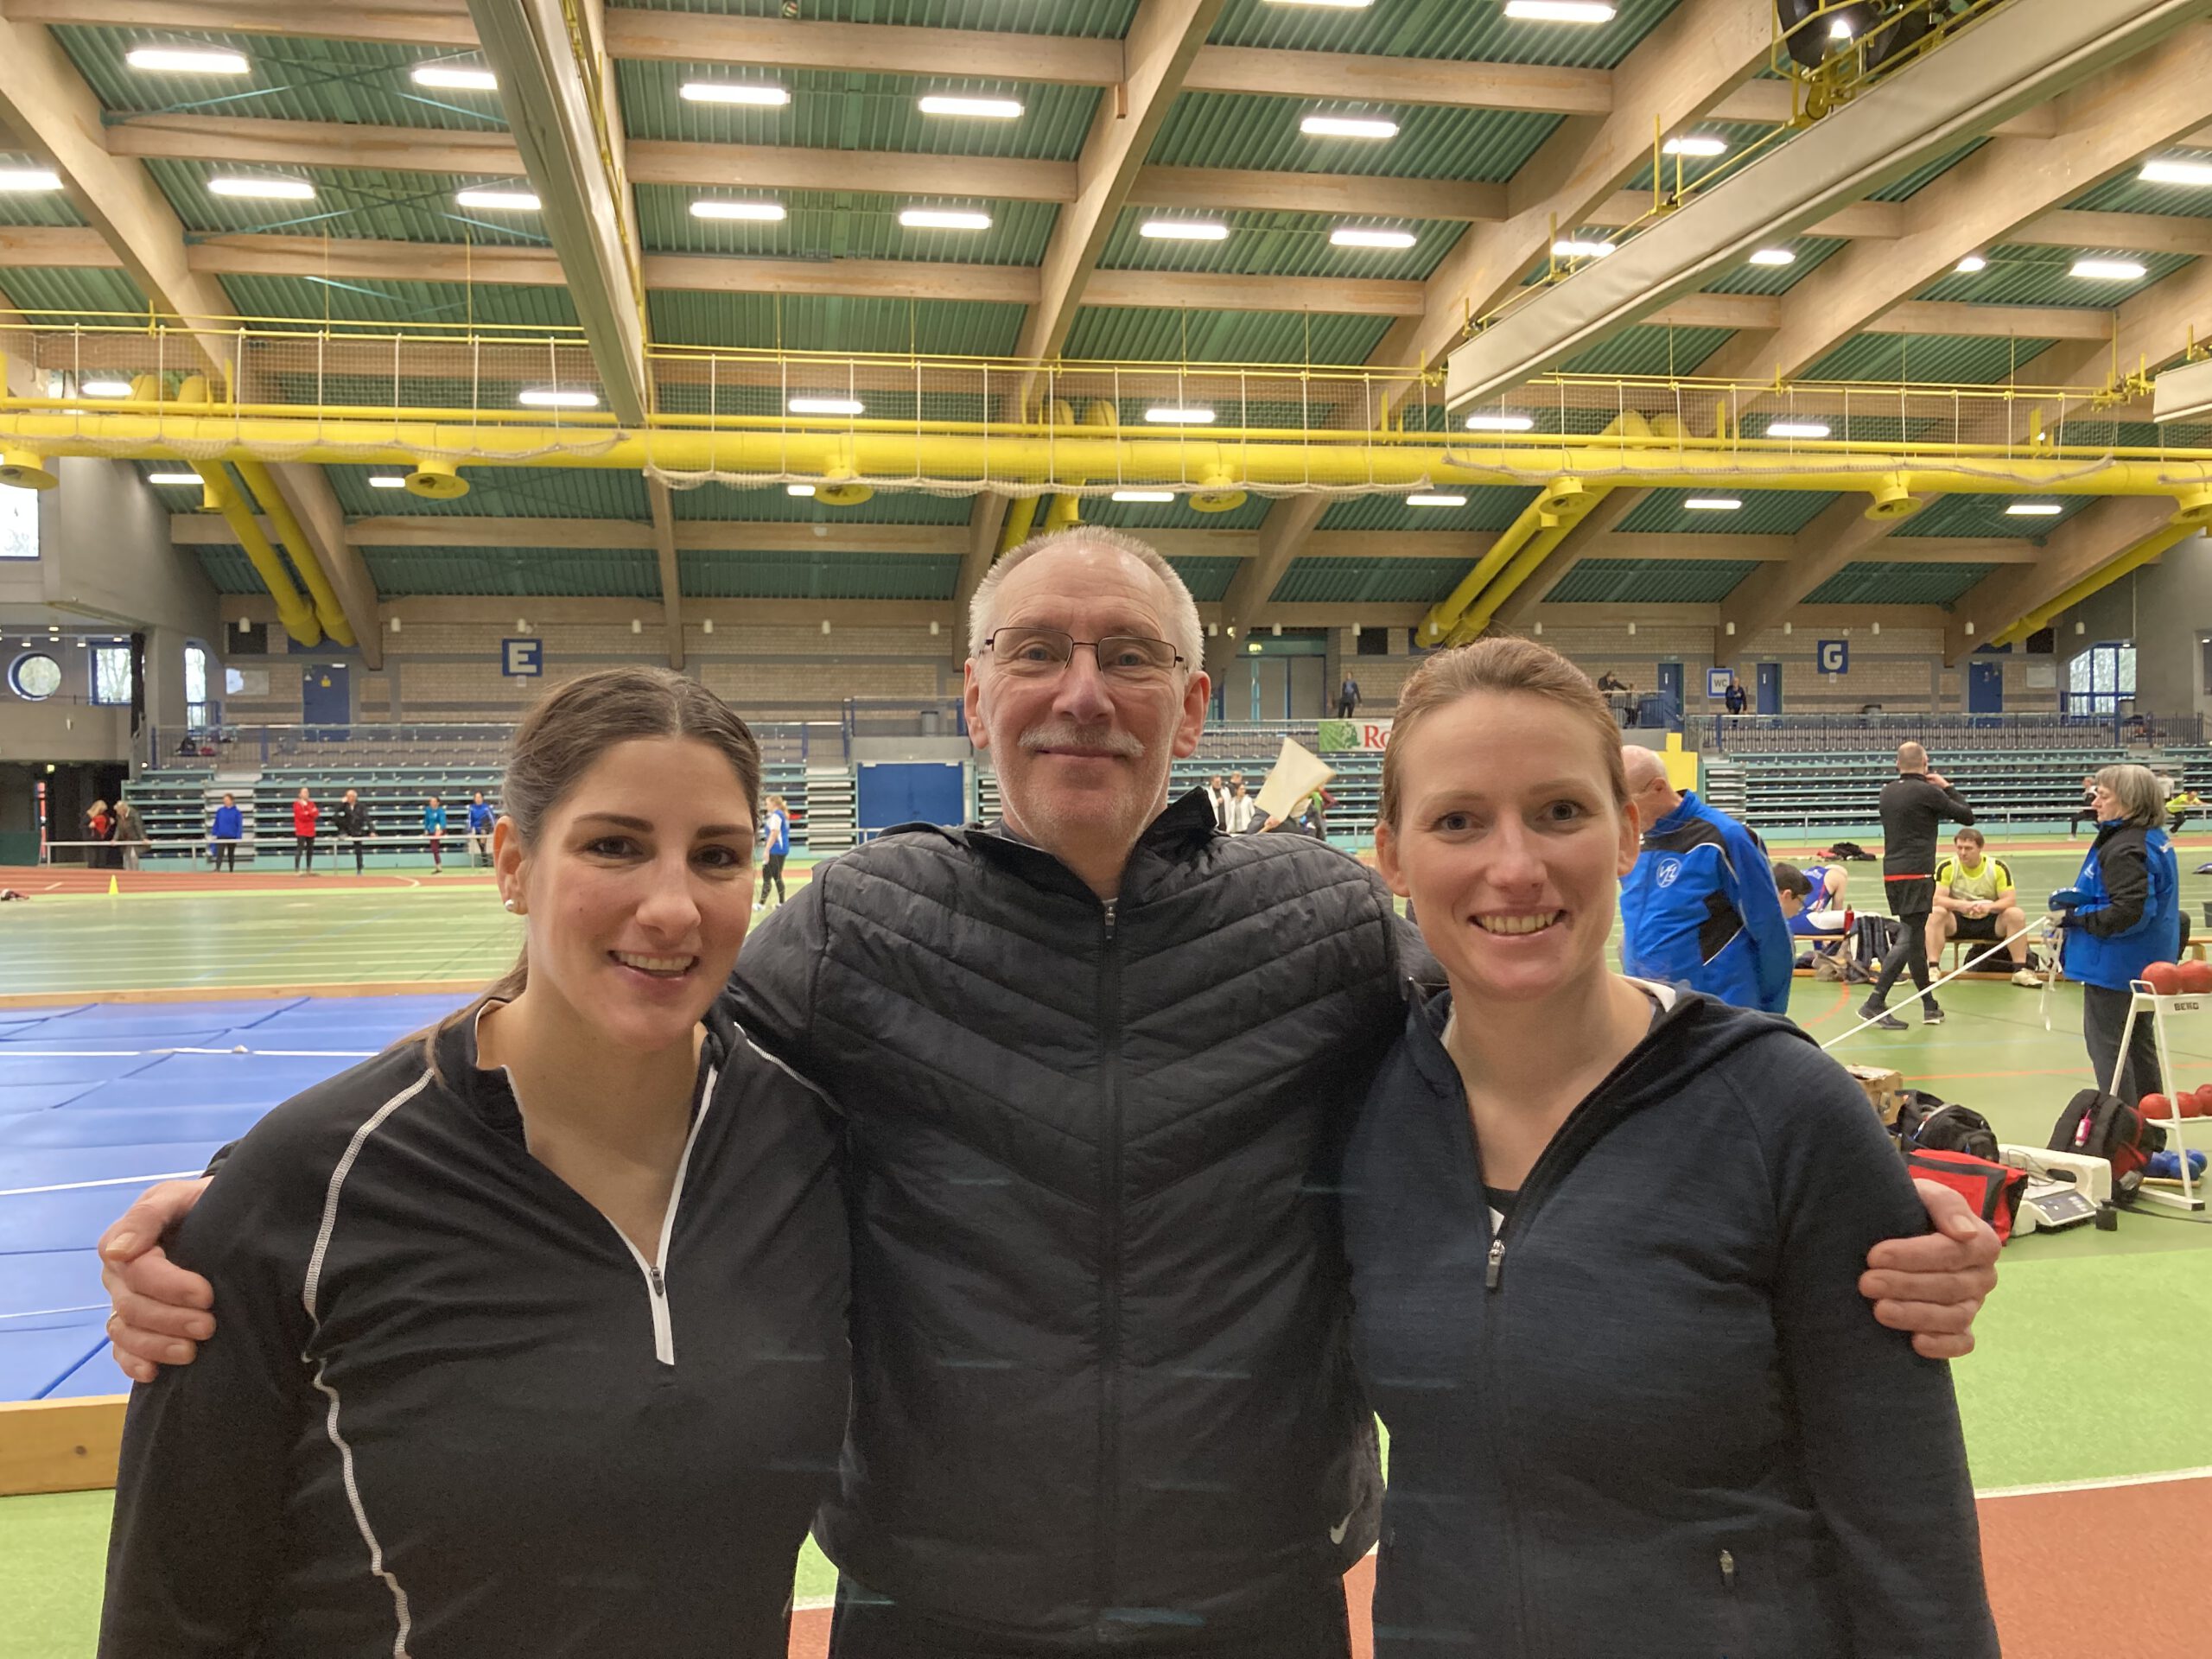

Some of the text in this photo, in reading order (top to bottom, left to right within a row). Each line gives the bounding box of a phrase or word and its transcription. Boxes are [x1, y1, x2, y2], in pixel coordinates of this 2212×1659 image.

[508, 642, 537, 673] E
[1823, 643, 1843, 671] G
[1713, 678, 1728, 688] WC
[2173, 1002, 2200, 1012] BERG
